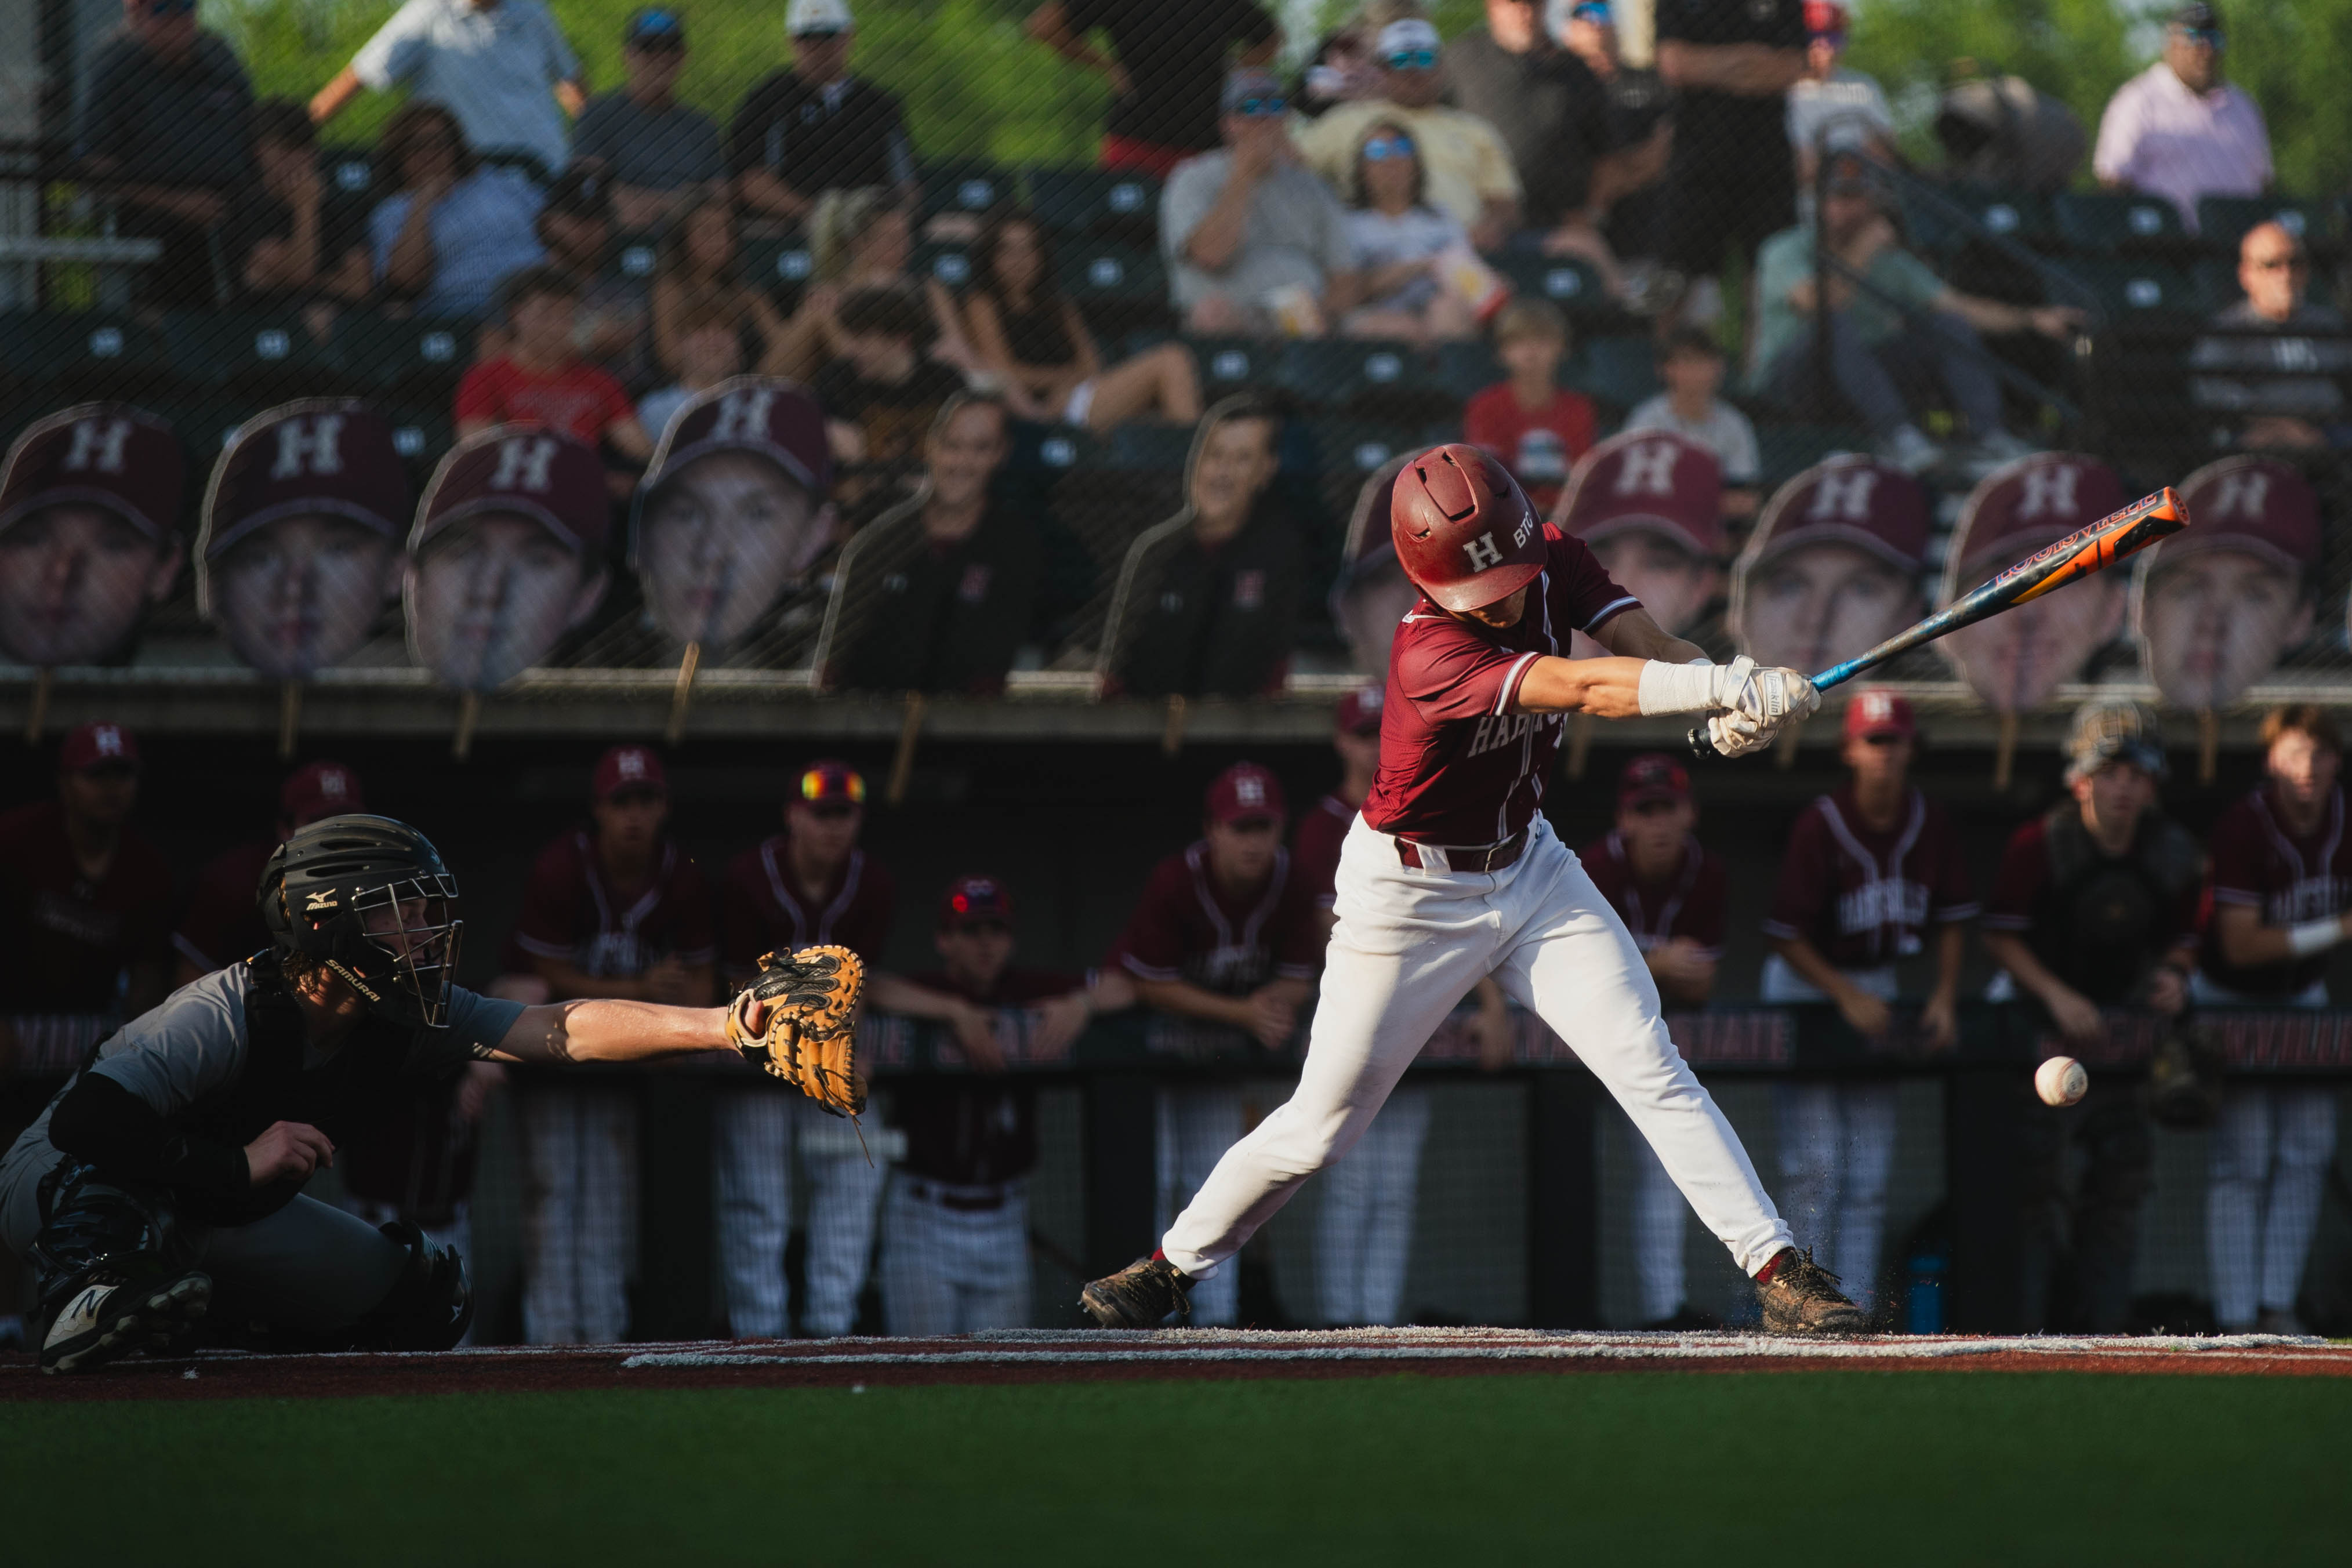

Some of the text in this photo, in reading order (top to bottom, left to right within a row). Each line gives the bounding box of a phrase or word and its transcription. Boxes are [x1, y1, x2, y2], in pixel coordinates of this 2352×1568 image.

[713, 390, 775, 441] H
[66, 420, 130, 473] H
[271, 415, 342, 479] H
[491, 438, 558, 491] H
[1614, 441, 1681, 496] H
[1810, 471, 1876, 520] H
[2018, 465, 2079, 516] H
[1462, 531, 1503, 573] H
[1513, 511, 1533, 549] BTC
[325, 959, 381, 1002] SAMURAI
